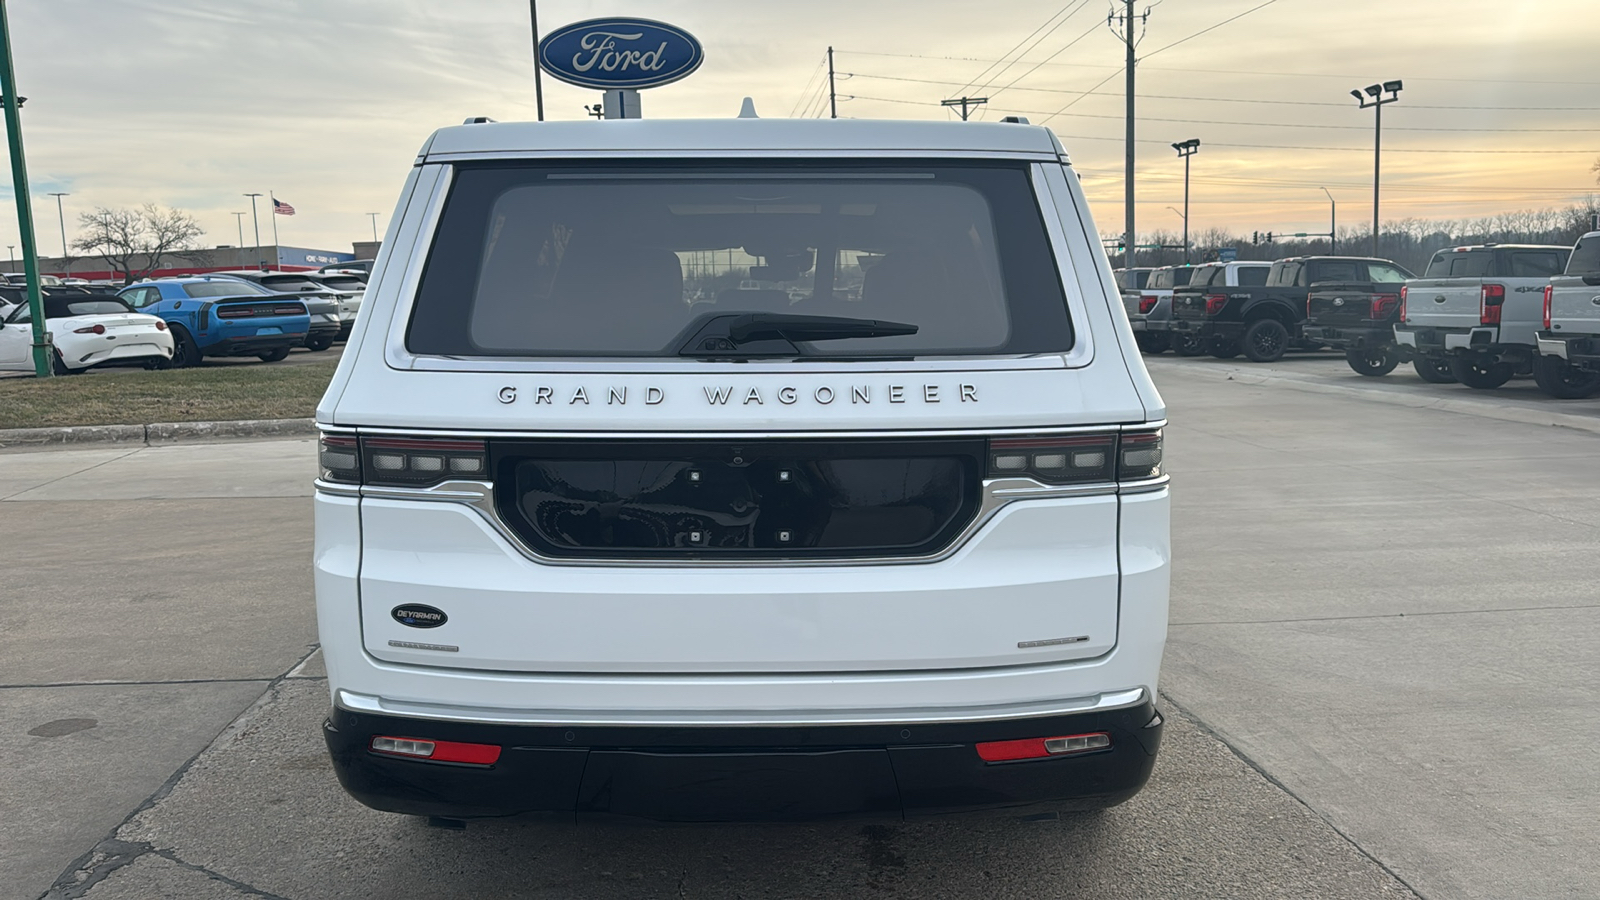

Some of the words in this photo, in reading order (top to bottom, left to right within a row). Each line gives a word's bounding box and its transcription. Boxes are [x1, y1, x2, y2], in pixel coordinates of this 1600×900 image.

[572, 31, 668, 72] Ford
[497, 386, 664, 404] GRAND
[703, 384, 978, 404] WAGONEER
[397, 610, 441, 620] DEYARMAN
